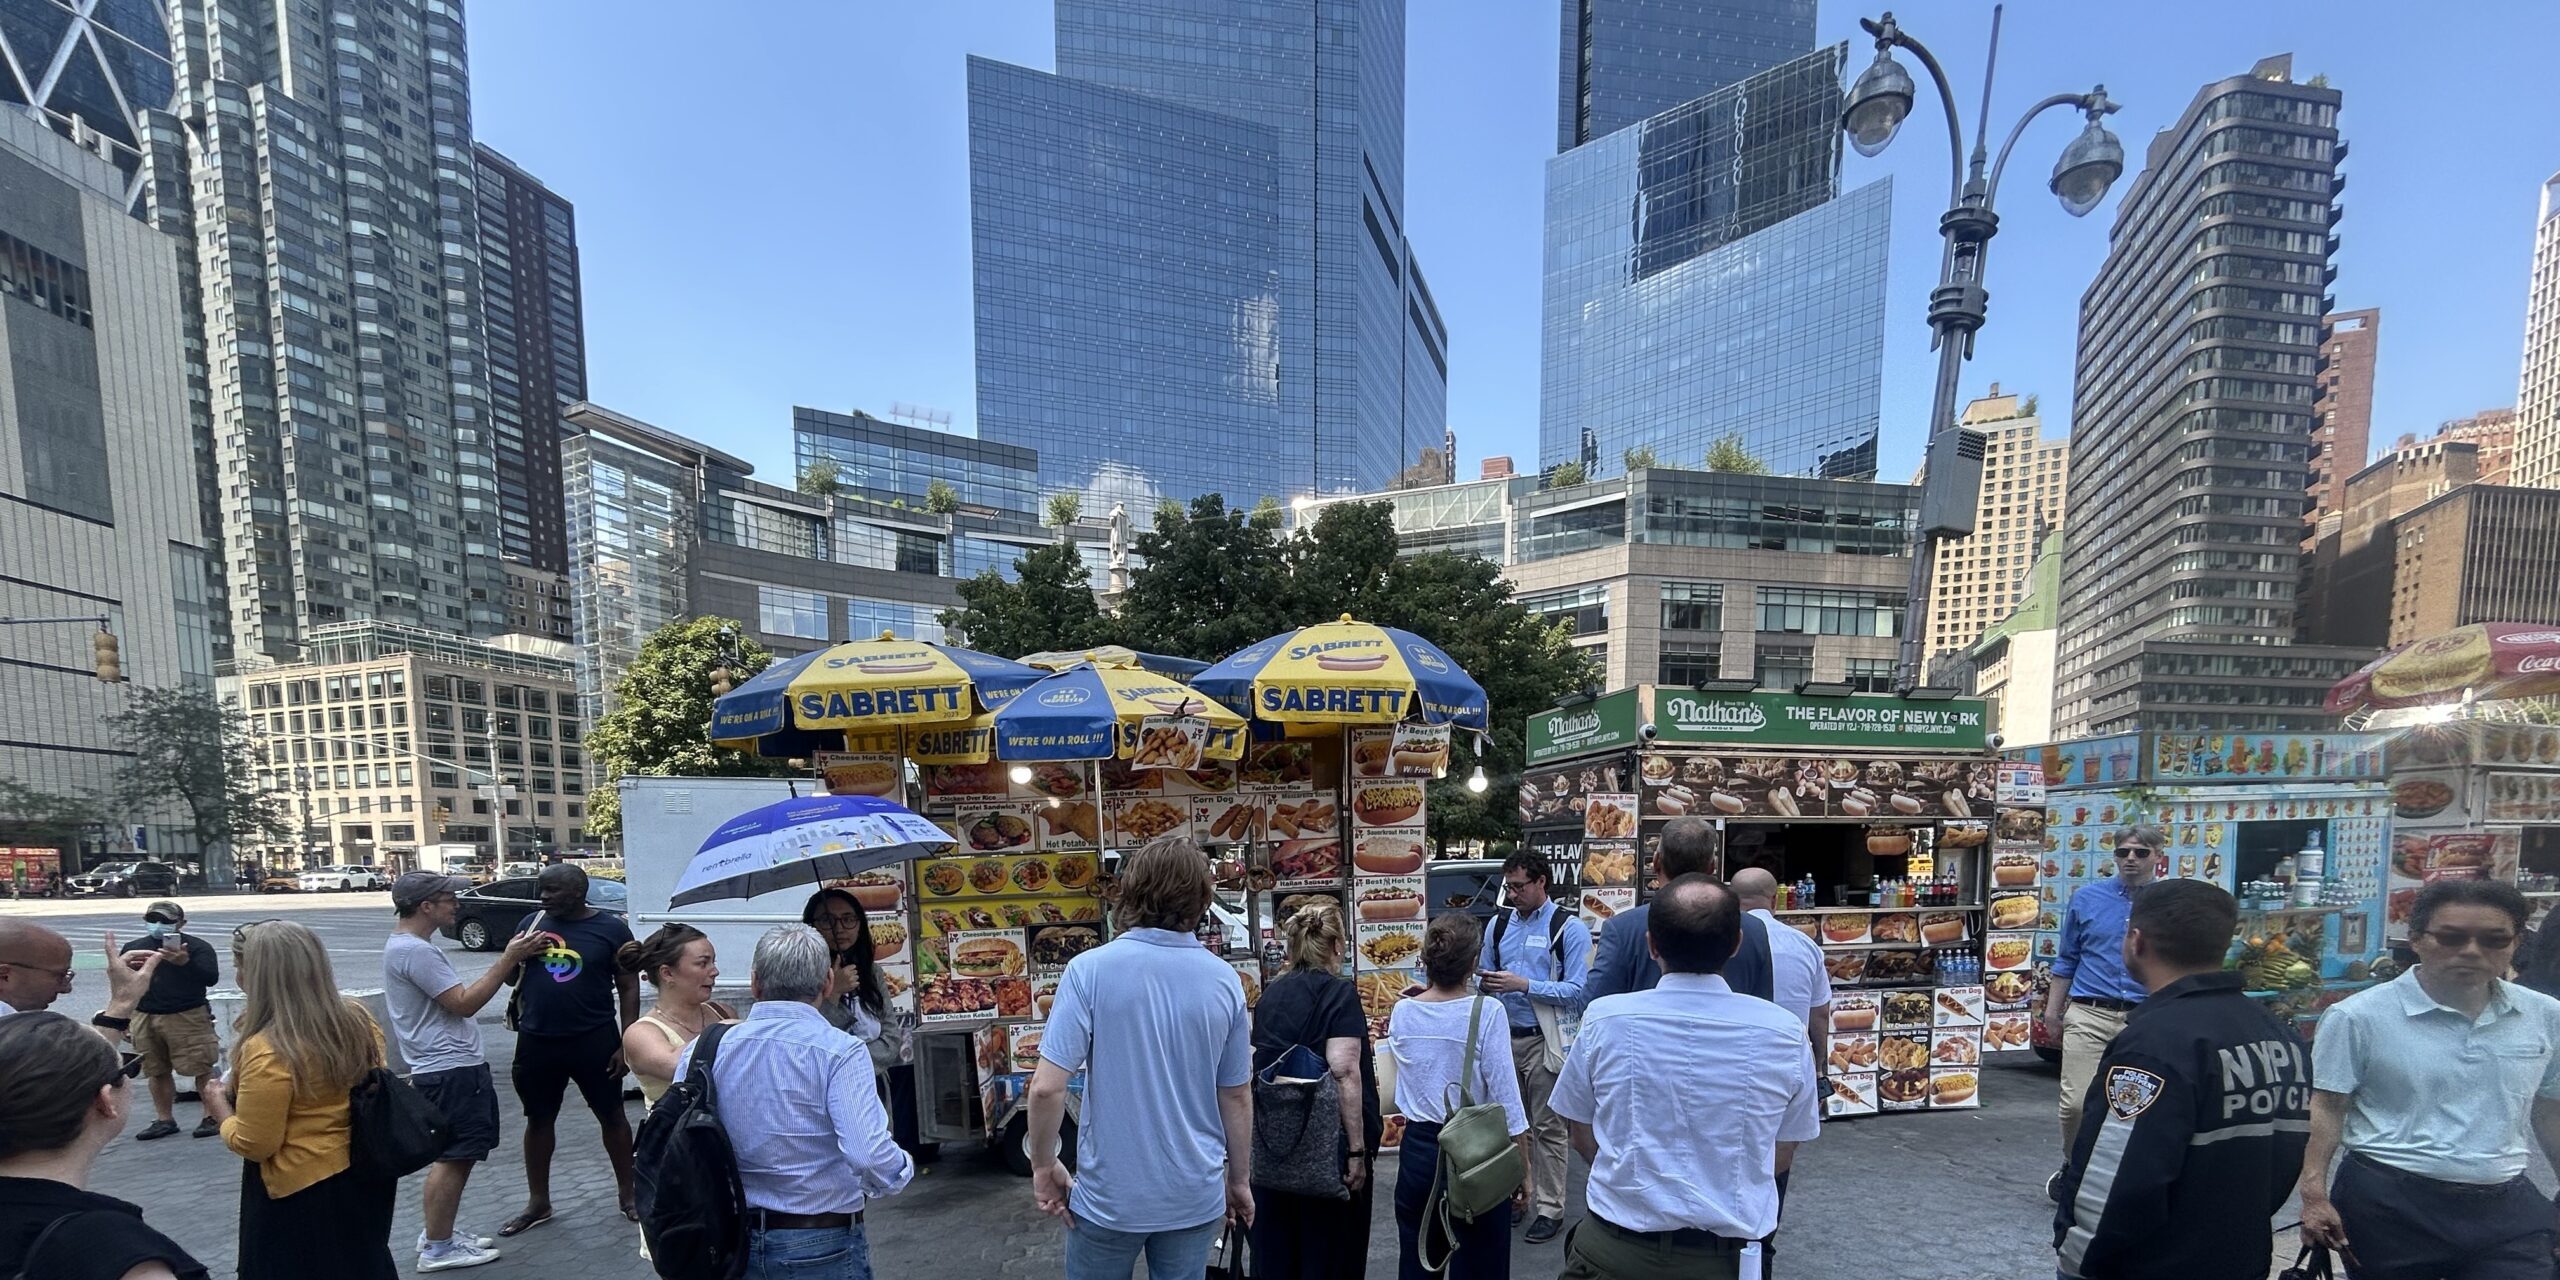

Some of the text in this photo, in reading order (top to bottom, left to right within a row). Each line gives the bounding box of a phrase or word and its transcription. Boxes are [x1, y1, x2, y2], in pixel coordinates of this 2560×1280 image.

[1288, 640, 1383, 660] SABRETT
[824, 651, 929, 668] SABRETT
[985, 689, 1009, 700] WE'RE
[1116, 687, 1185, 702] SABRETT
[1261, 684, 1406, 713] SABRETT
[799, 684, 963, 720] SABRETT
[943, 711, 960, 719] 2023
[1667, 698, 1766, 725] Nathan's
[1786, 706, 1979, 726] THE FLAVOR OF NEW YRK
[1548, 708, 1601, 738] Nathan's
[1810, 722, 1837, 731] OPERATED
[1838, 722, 1846, 731] BY
[1846, 722, 1856, 731] Y2J
[1410, 727, 1428, 735] Best
[917, 728, 989, 756] SABRETT
[1008, 733, 1105, 747] WE'RE ON A ROLL !!!
[830, 754, 861, 762] Cheese
[878, 754, 895, 762] Dog
[1414, 766, 1432, 774] Fries
[1192, 796, 1234, 805] Corn Dog
[1046, 840, 1061, 848] Hot
[1062, 840, 1087, 848] Potato
[1555, 844, 1582, 860] FLAV
[702, 853, 752, 873] rentbrella
[1947, 862, 1957, 875] A
[1407, 877, 1422, 885] Dog
[1618, 888, 1633, 897] Dog
[1360, 922, 1424, 933] Chili Cheese Fries
[2124, 1070, 2150, 1081] POLICE
[2112, 1074, 2158, 1091] DEPARTMENT
